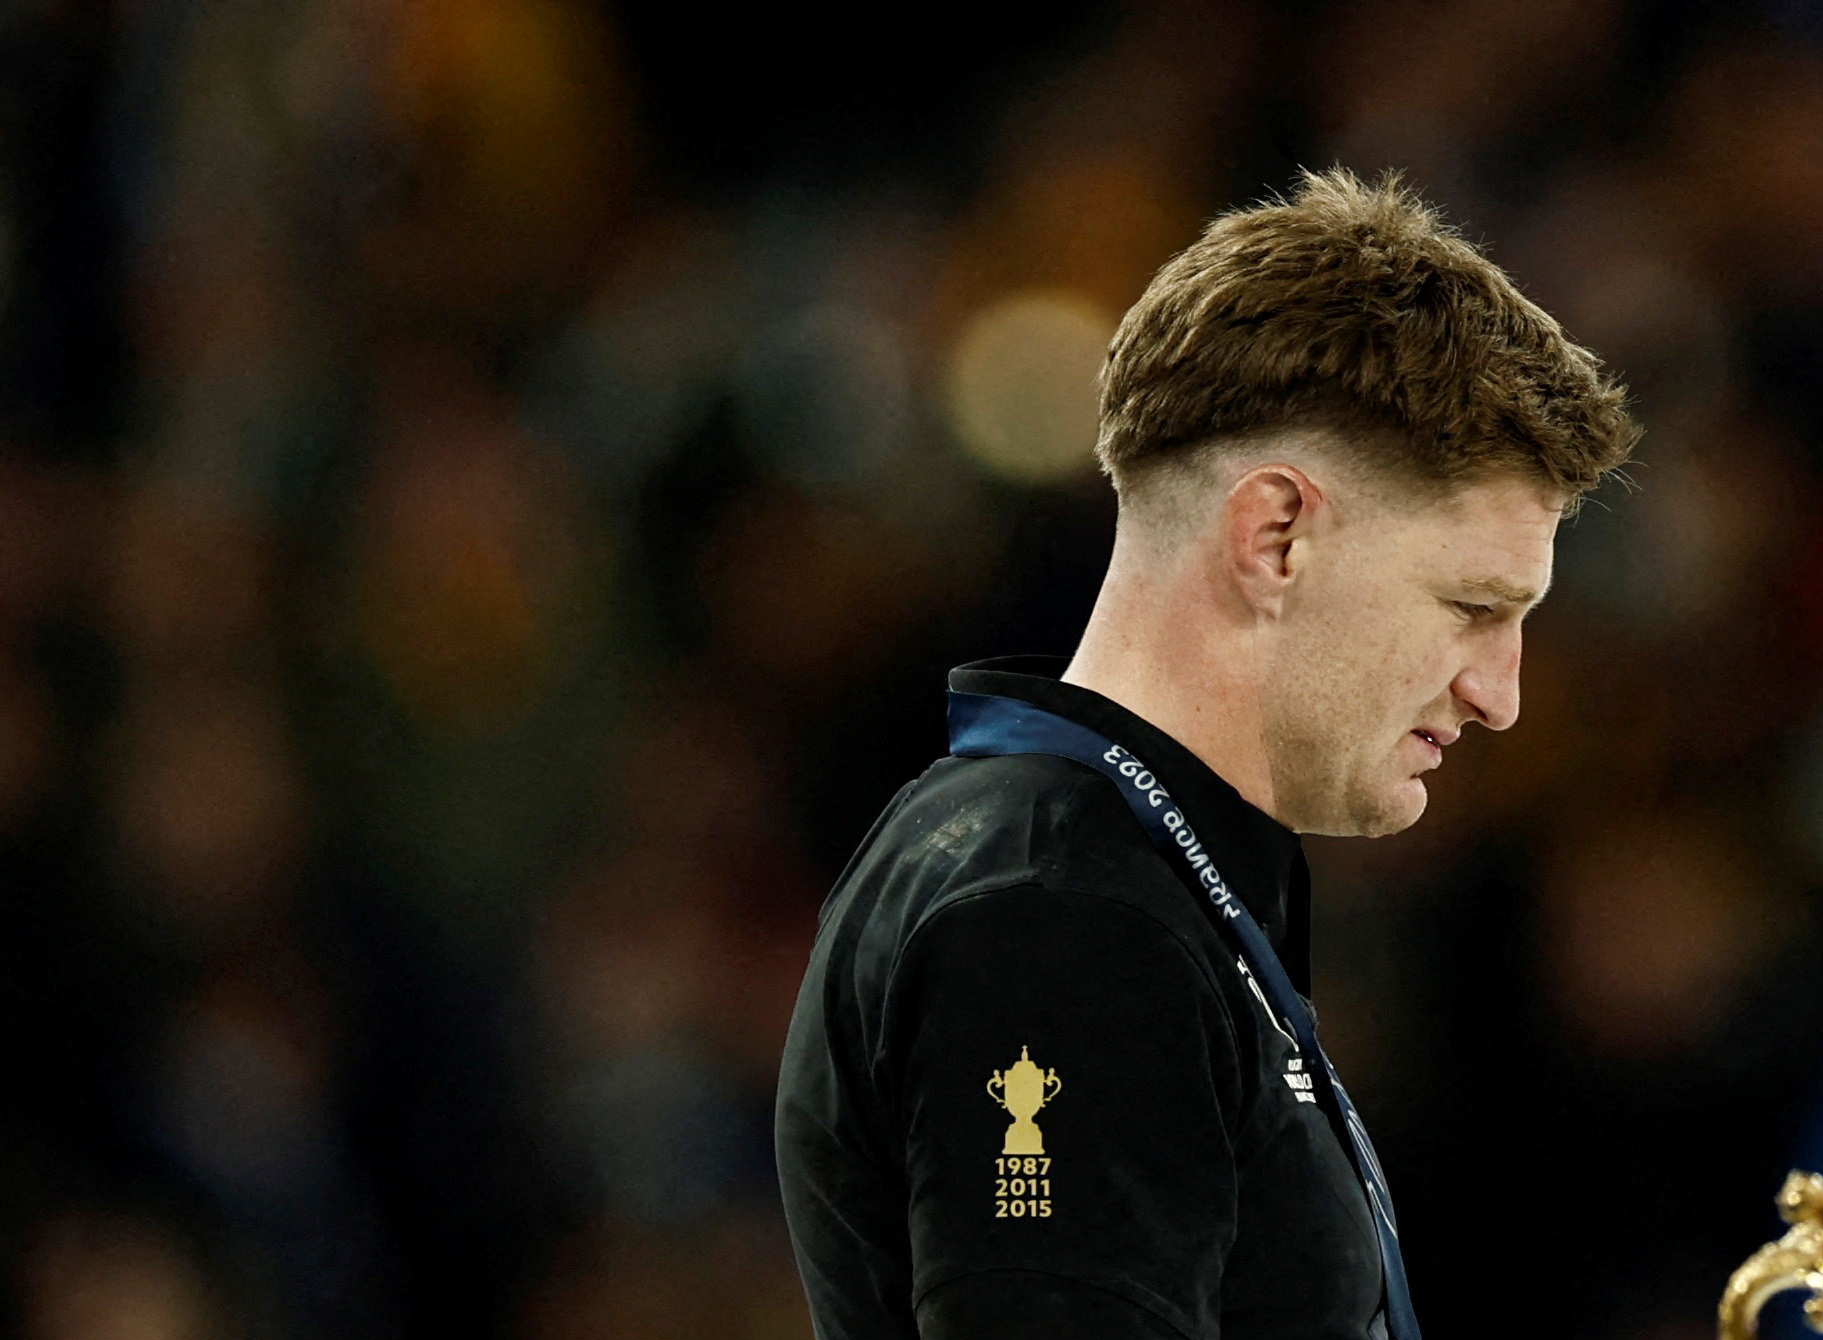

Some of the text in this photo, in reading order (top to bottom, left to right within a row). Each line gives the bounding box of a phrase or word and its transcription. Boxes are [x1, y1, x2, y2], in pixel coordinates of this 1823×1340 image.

[1102, 744, 1171, 808] 2023
[995, 1157, 1052, 1176] 1987
[995, 1178, 1051, 1197] 2011
[995, 1199, 1052, 1218] 2015
